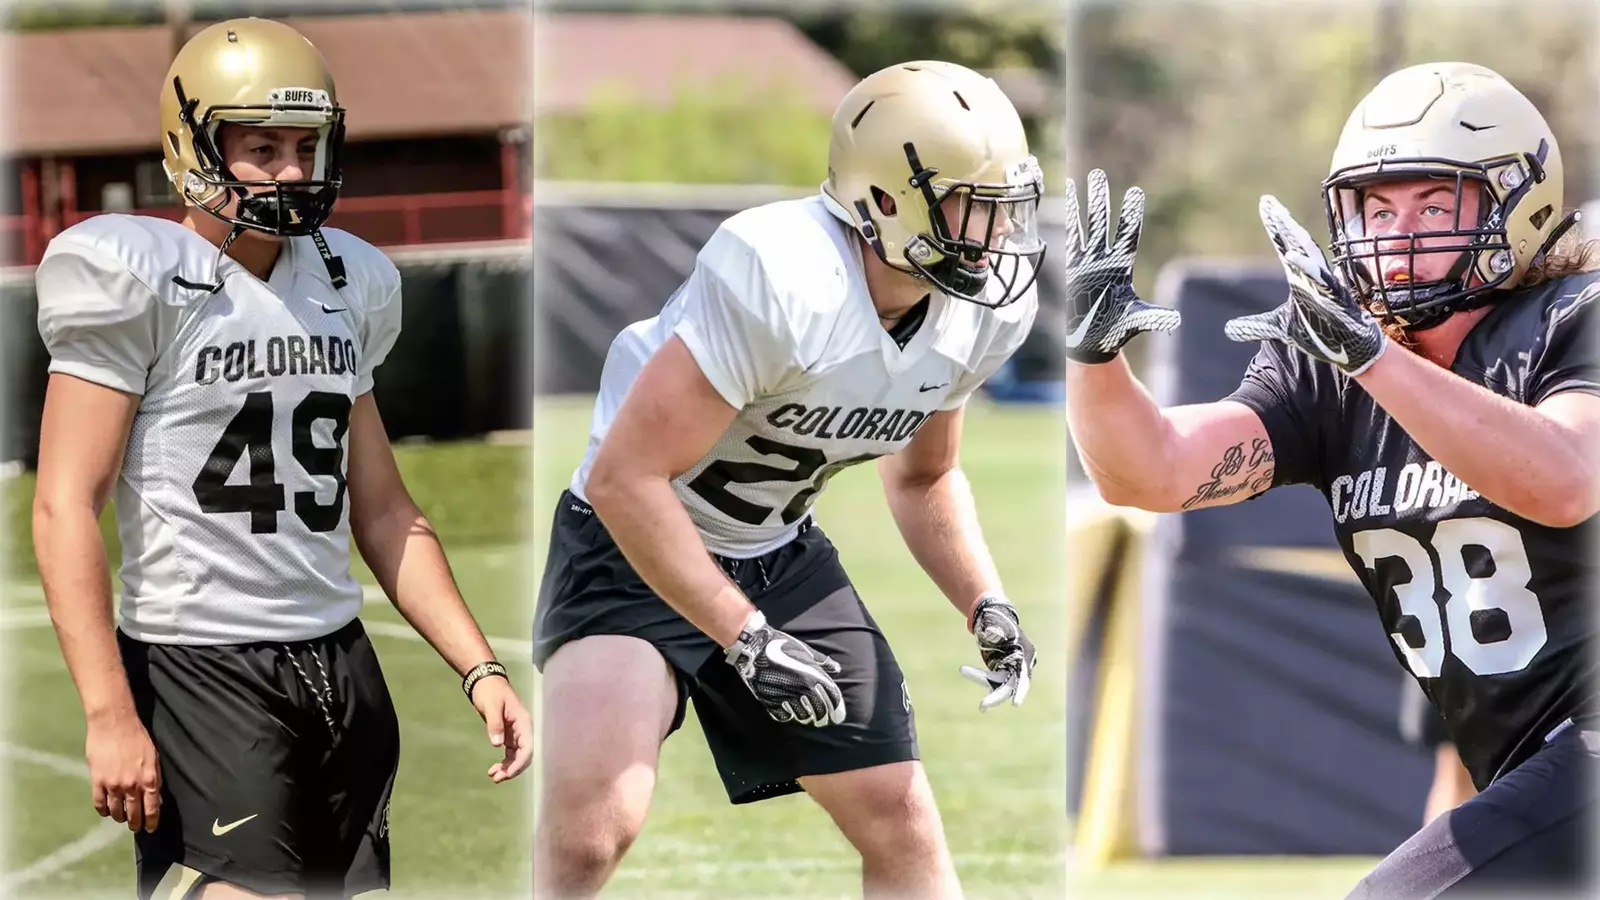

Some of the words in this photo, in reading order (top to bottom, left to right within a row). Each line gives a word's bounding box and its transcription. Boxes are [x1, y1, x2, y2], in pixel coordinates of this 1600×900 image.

[284, 90, 313, 102] BUFFS
[195, 335, 357, 386] COLORADO
[766, 403, 937, 442] COLORAD
[192, 390, 353, 534] 49
[1331, 461, 1480, 524] COLORA
[1352, 516, 1548, 678] 38
